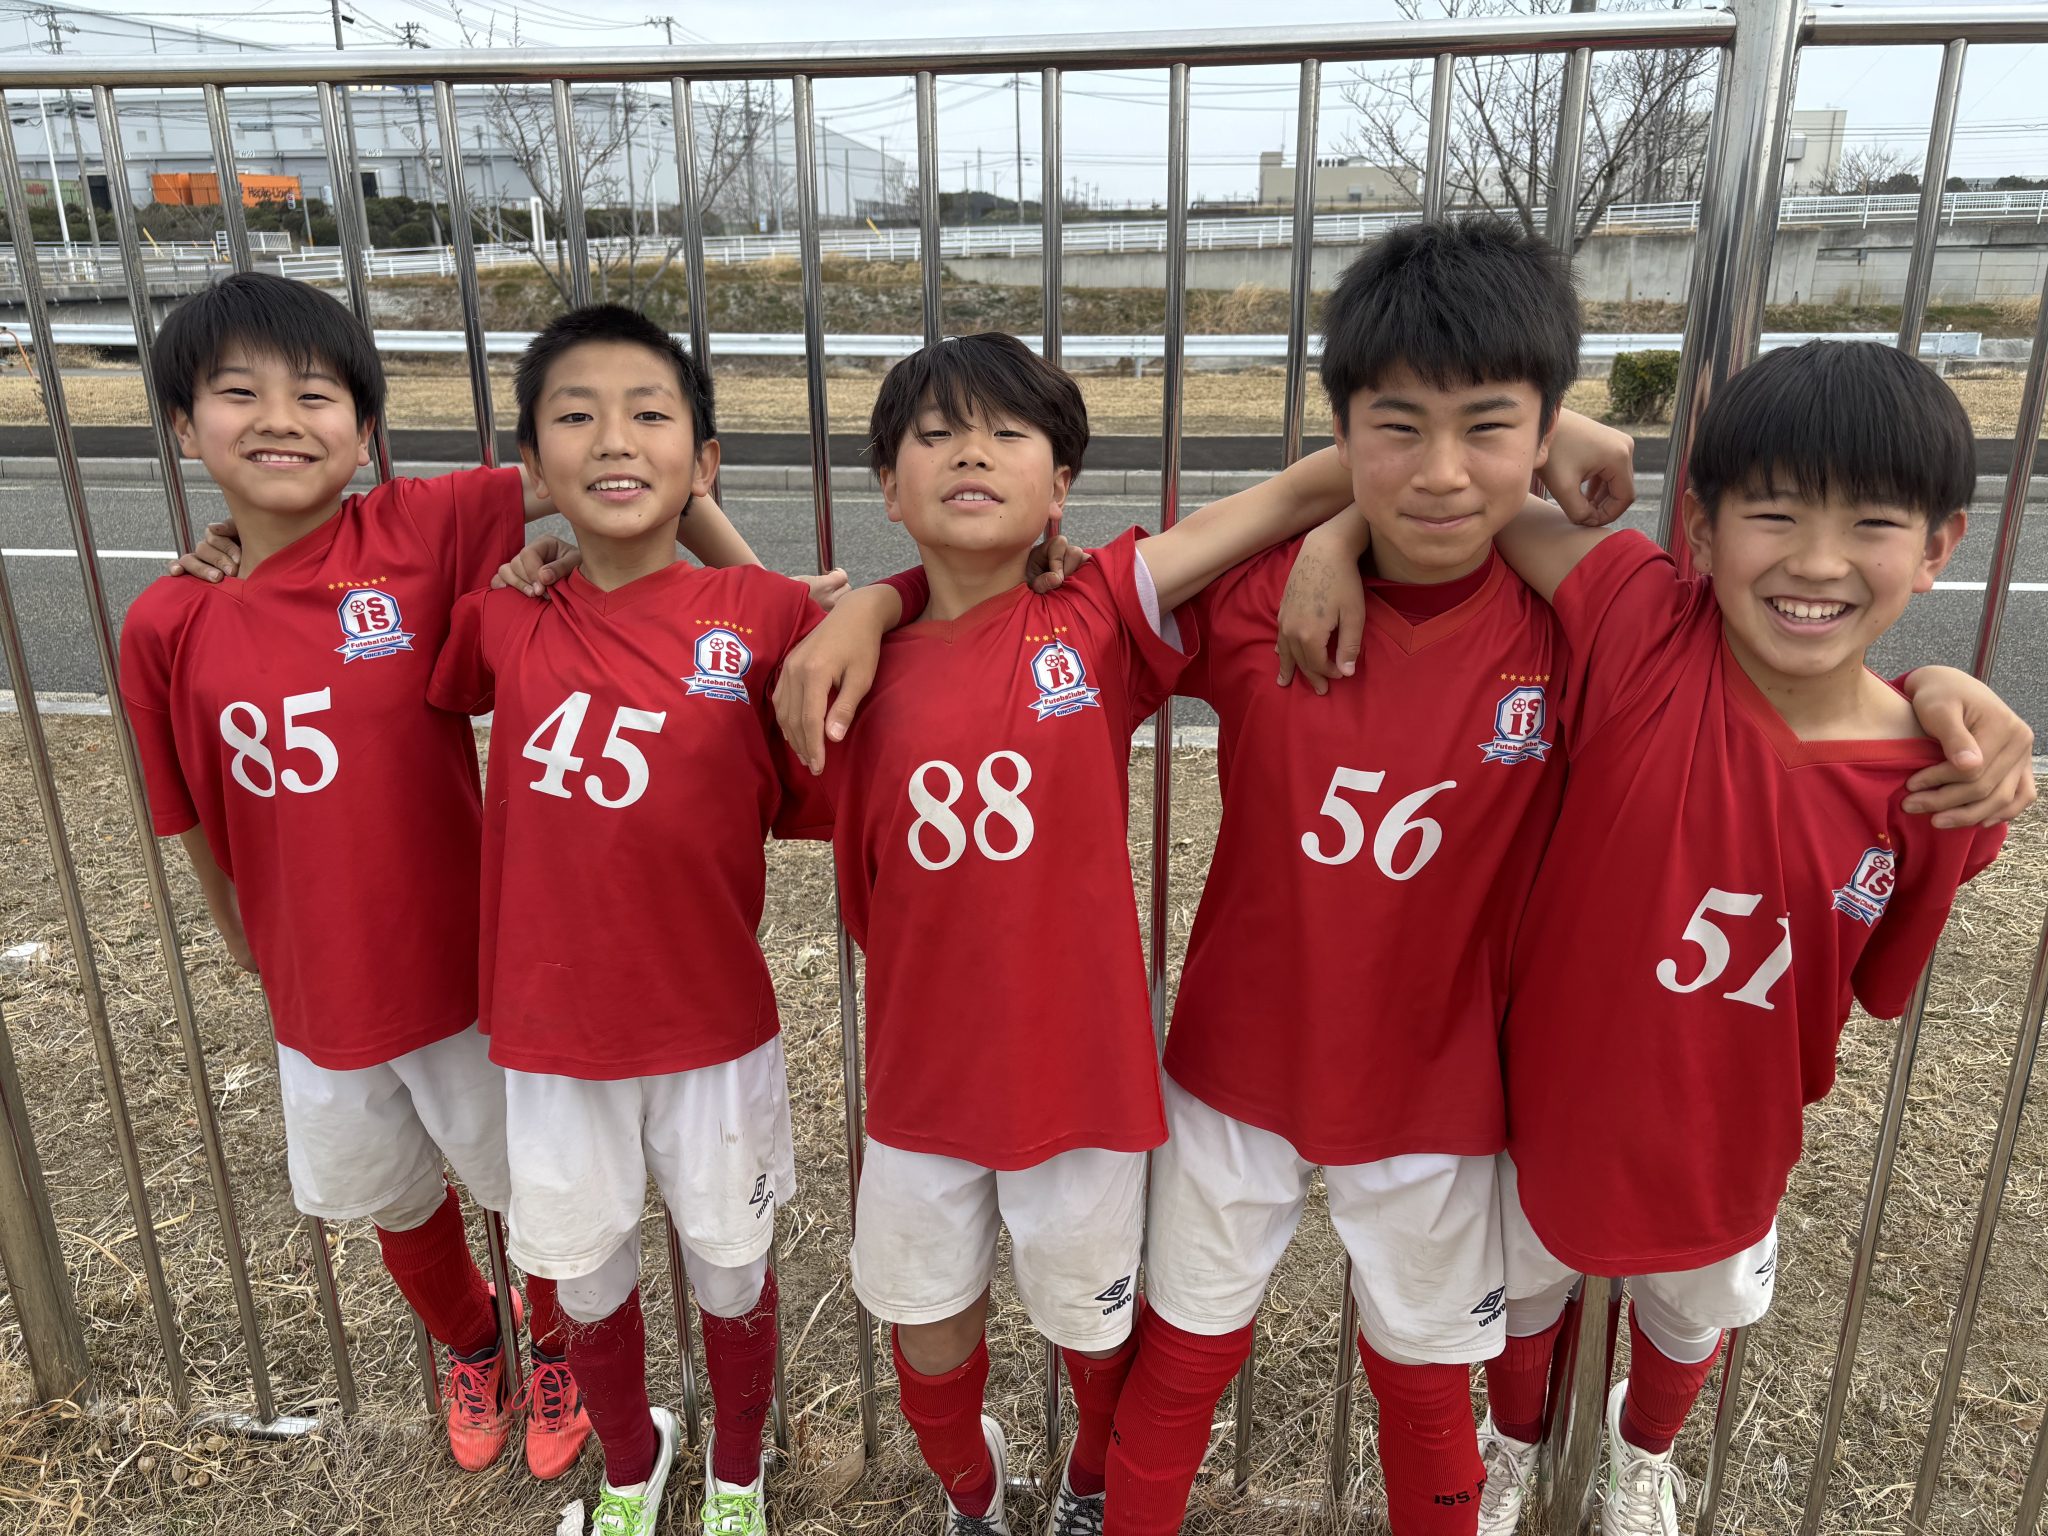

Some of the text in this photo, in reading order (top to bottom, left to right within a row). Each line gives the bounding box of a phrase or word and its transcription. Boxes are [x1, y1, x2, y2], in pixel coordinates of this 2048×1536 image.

[220, 686, 339, 798] 85
[522, 691, 667, 809] 45
[907, 750, 1035, 871] 88
[1301, 766, 1457, 881] 56
[1656, 887, 1792, 1010] 51
[756, 1190, 774, 1219] umbro
[1102, 1292, 1132, 1316] umbro
[1478, 1302, 1506, 1328] umbro
